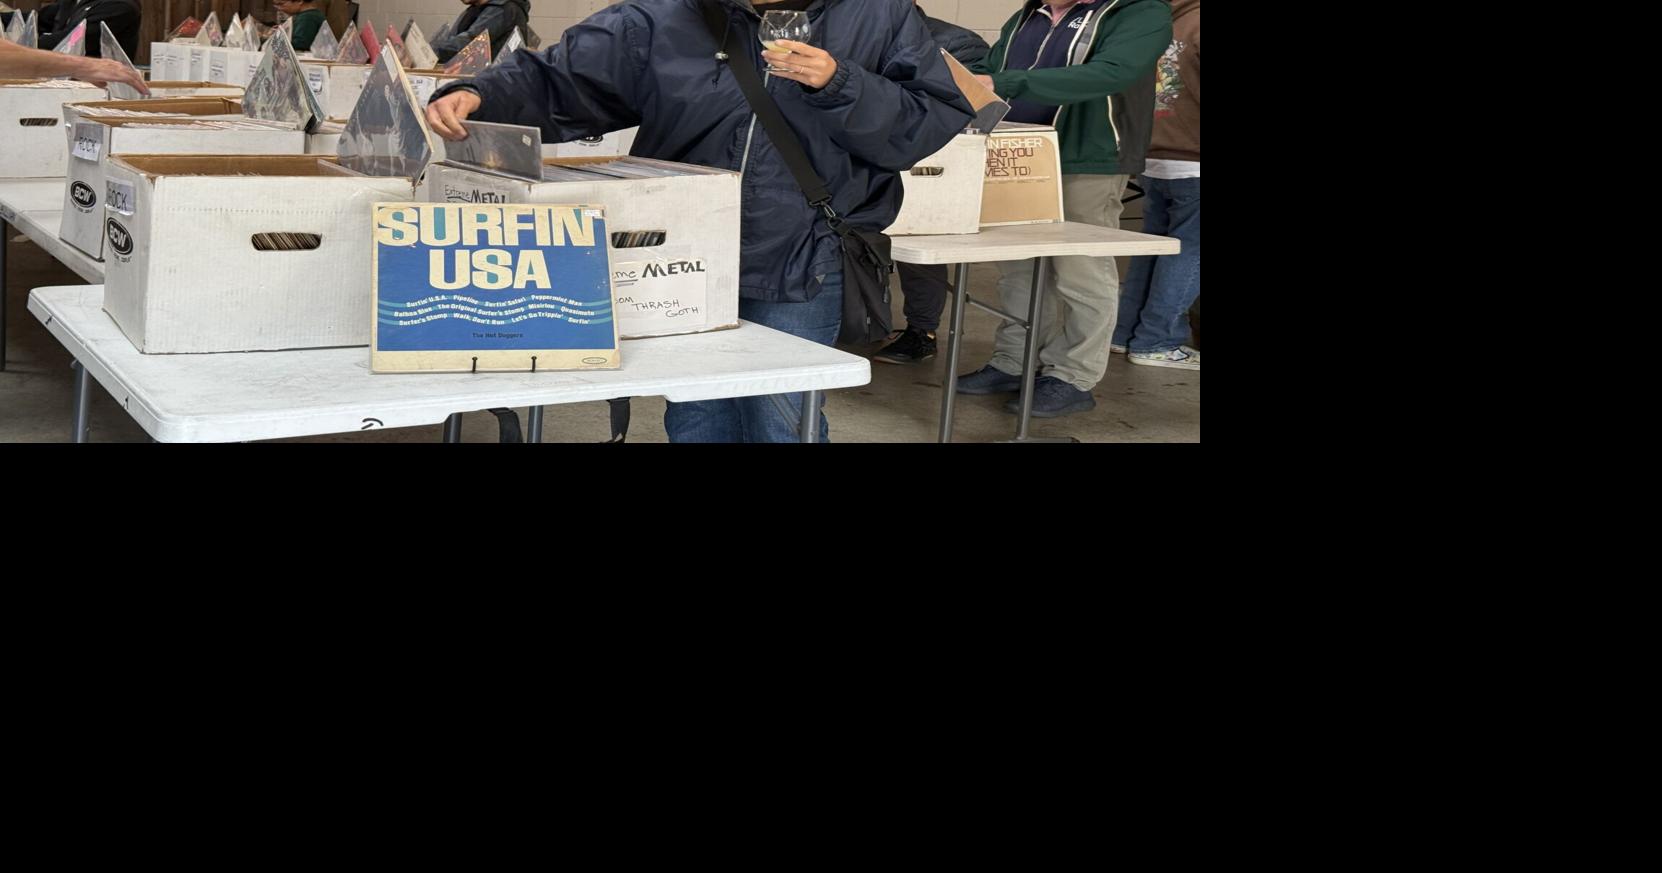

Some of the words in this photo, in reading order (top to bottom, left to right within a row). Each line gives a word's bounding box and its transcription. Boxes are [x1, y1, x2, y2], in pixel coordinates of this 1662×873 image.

[1000, 137, 1042, 149] FISHER
[1009, 147, 1034, 158] YOU
[1007, 157, 1018, 167] IT
[1011, 166, 1032, 177] TO)
[74, 185, 92, 203] BCW
[106, 187, 128, 212] ROCK
[377, 207, 603, 247] SURFIN
[109, 224, 127, 248] BCW
[429, 249, 552, 290] USA
[641, 260, 706, 279] METAL
[453, 294, 479, 305] Pipeline
[530, 294, 567, 304] Peppermint
[568, 299, 583, 307] Man
[631, 299, 681, 311] THRASH
[450, 303, 477, 313] Original
[665, 306, 699, 318] GOTH
[511, 314, 528, 323] Let's
